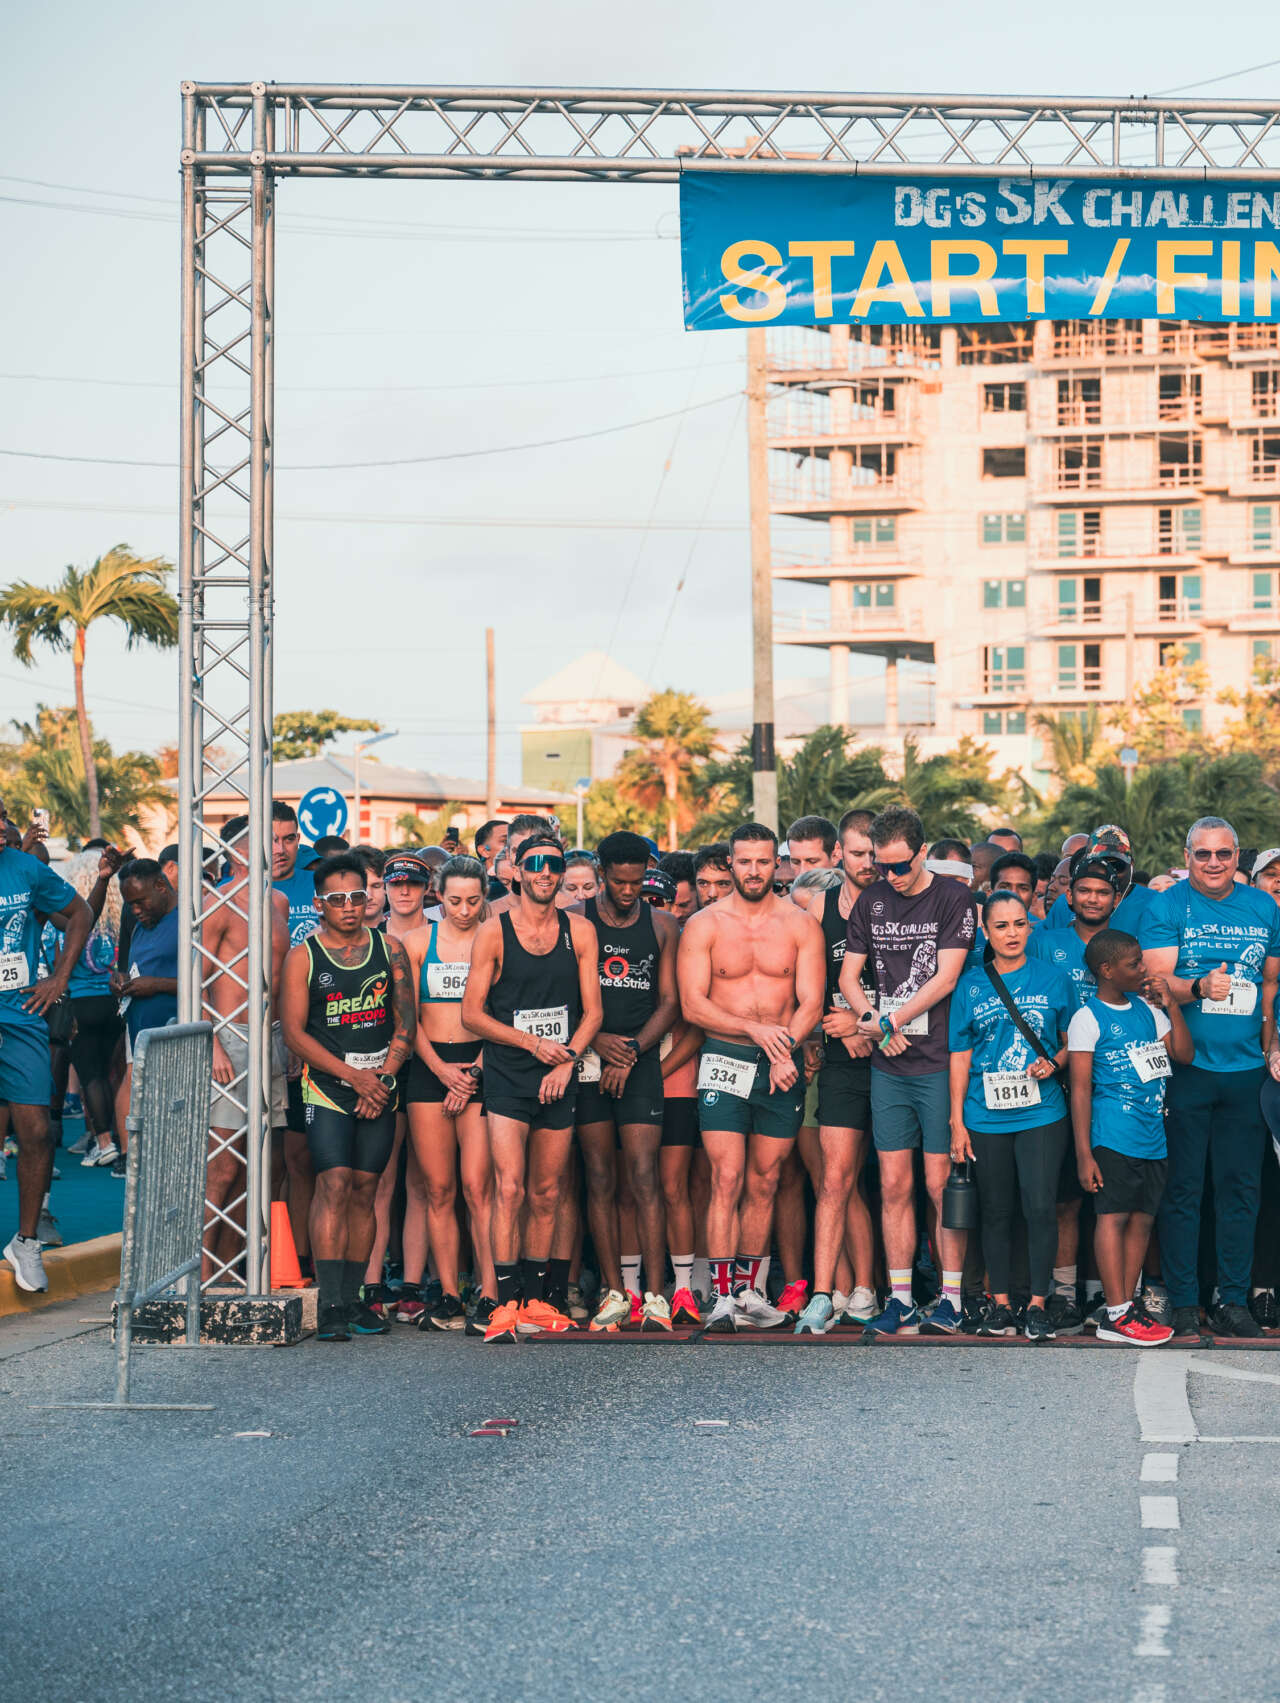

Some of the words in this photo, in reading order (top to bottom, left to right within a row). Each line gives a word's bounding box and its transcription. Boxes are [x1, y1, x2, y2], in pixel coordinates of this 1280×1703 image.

[895, 186, 987, 228] DG's
[995, 178, 1074, 226] 5K
[719, 240, 1069, 322] START
[1088, 238, 1132, 316] /
[326, 994, 388, 1016] BREAK
[1013, 995, 1049, 1005] ALLENGE
[327, 1016, 341, 1024] THE
[528, 1022, 562, 1038] 1530
[710, 1067, 738, 1086] 334
[993, 1084, 1029, 1101] 1814
